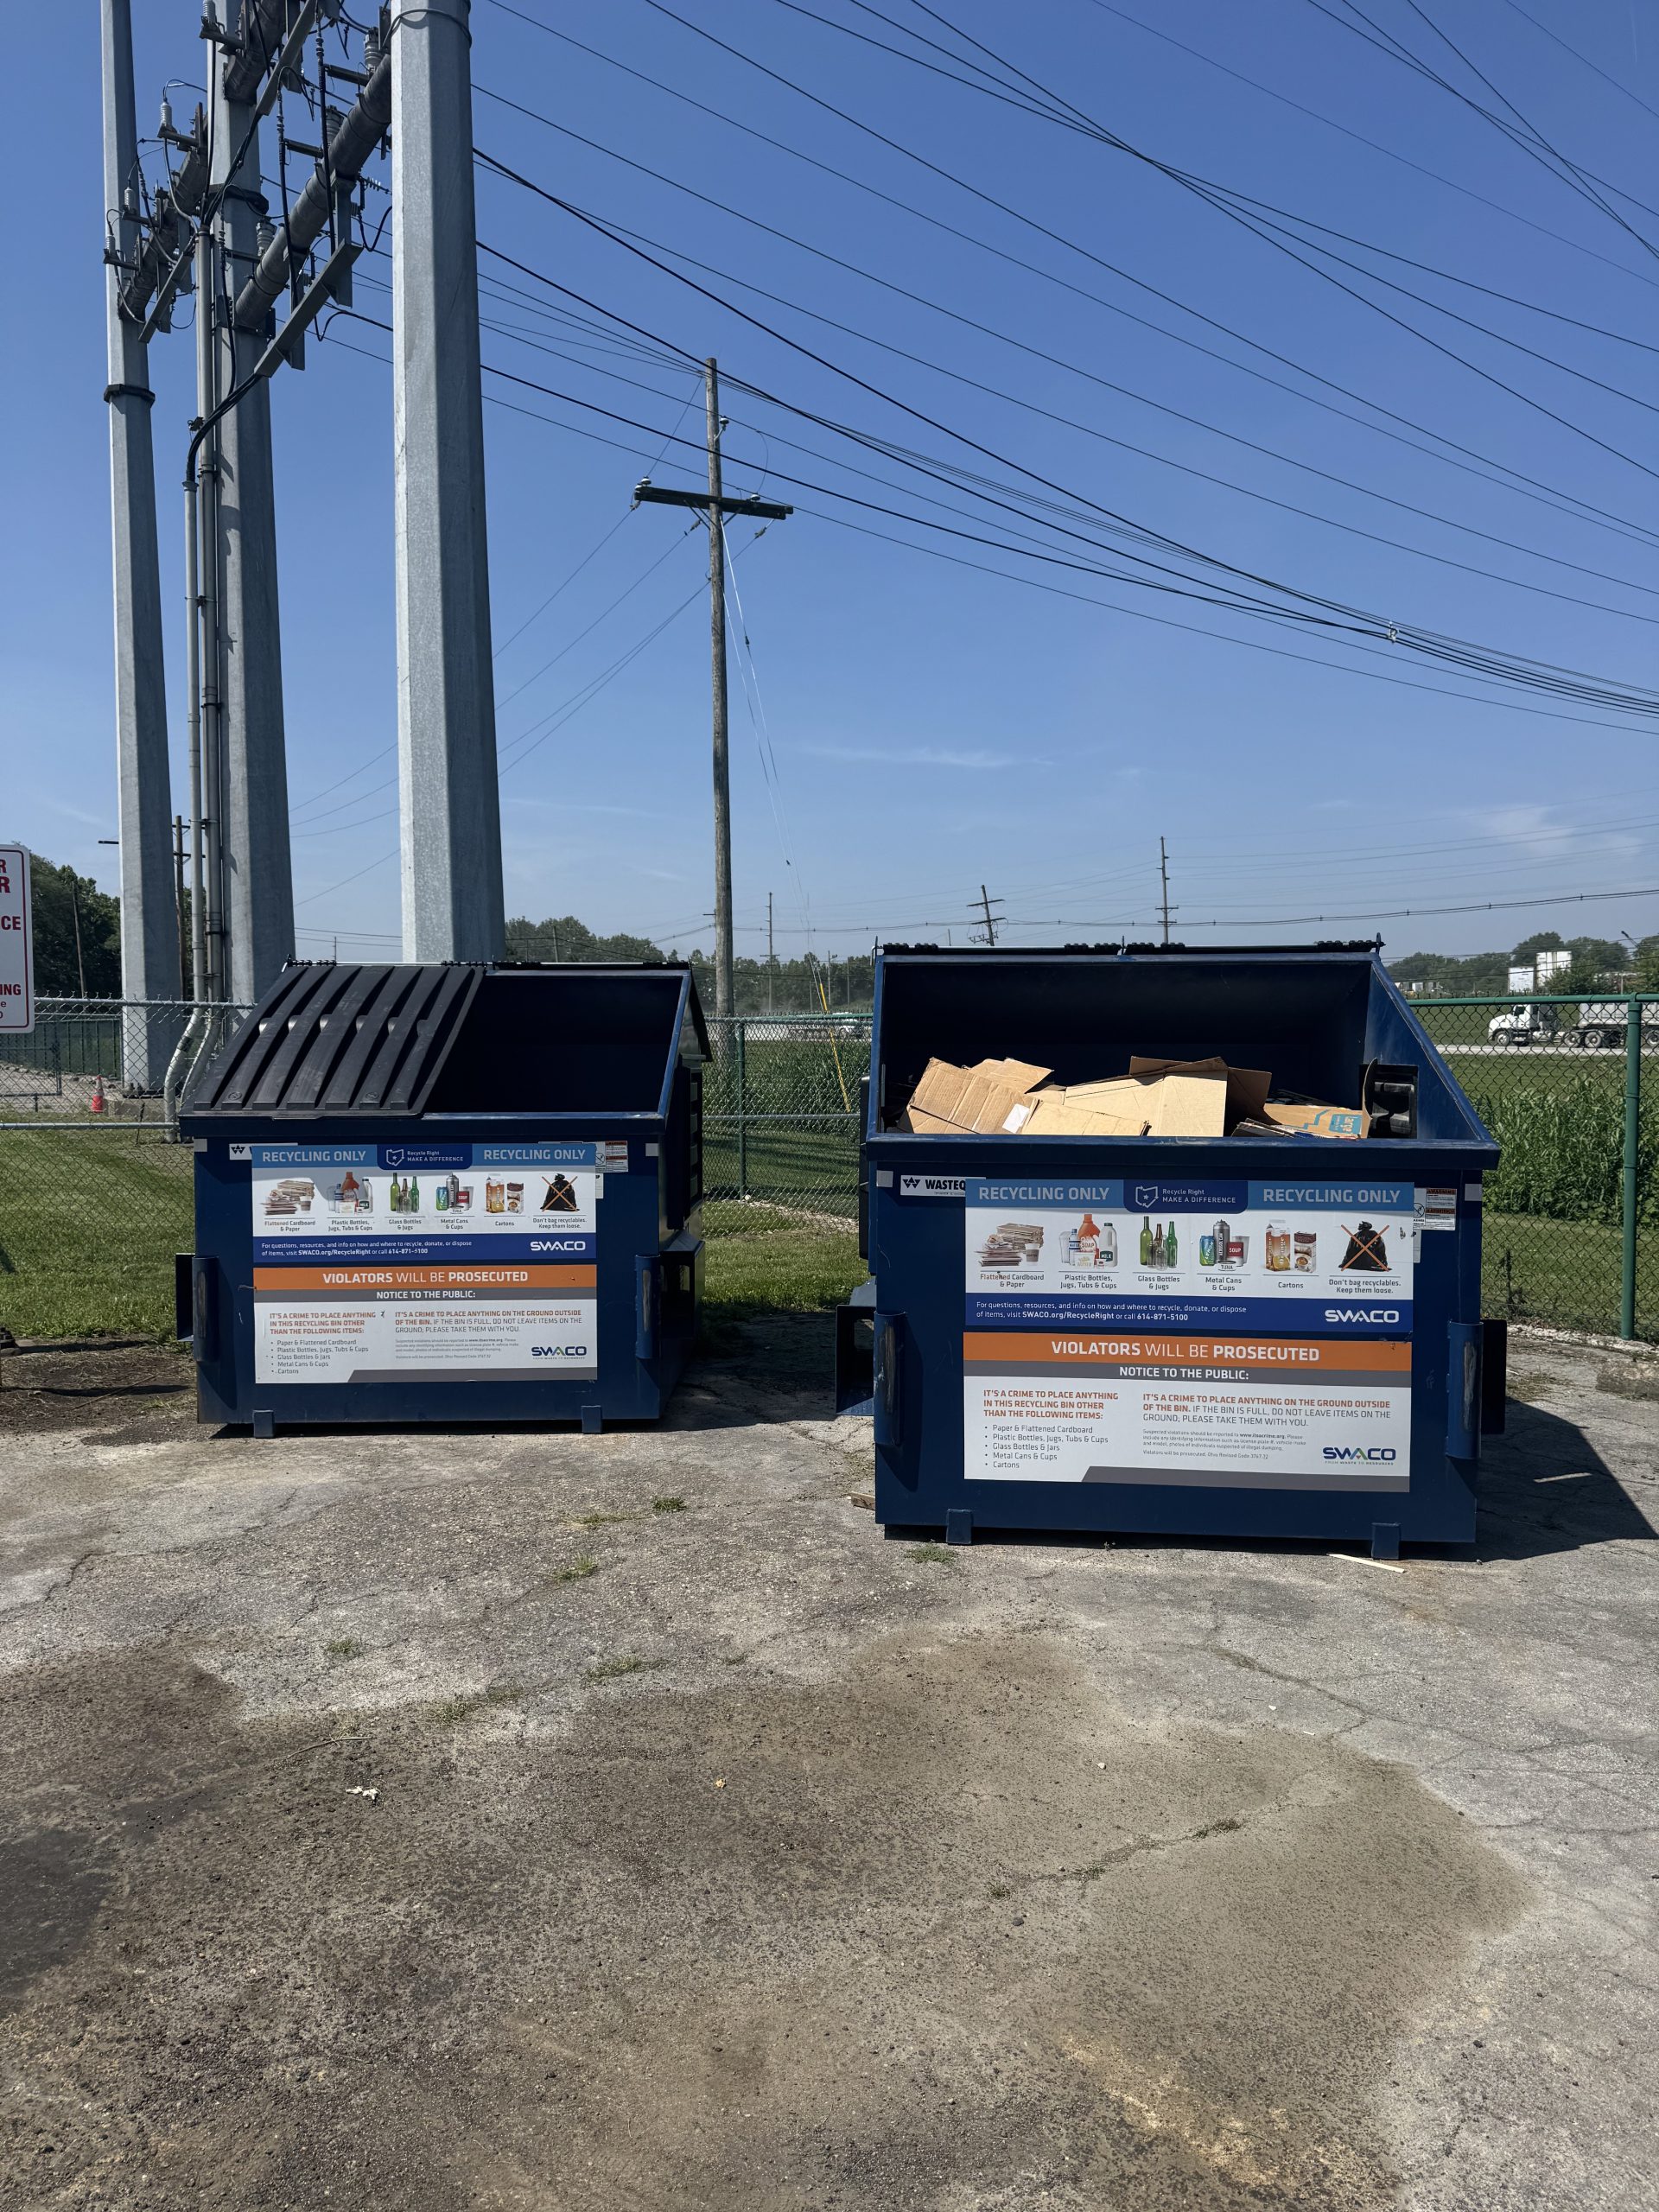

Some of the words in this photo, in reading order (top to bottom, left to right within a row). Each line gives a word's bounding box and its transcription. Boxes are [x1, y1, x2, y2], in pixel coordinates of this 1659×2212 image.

[262, 1150, 330, 1162] RECYCLING
[334, 1150, 365, 1161] ONLY
[483, 1148, 550, 1160] RECYCLING
[554, 1149, 585, 1160] ONLY
[979, 1186, 1064, 1199] RECYCLING
[1068, 1186, 1109, 1200] ONLY
[1263, 1188, 1352, 1203] RECYCLING
[1357, 1189, 1400, 1203] ONLY
[530, 1240, 586, 1251] SWACO
[322, 1272, 392, 1283] VIOLATORS
[396, 1272, 426, 1282] WILL
[429, 1271, 445, 1281] BE
[448, 1271, 528, 1281] PROSECUTED
[1348, 1279, 1361, 1287] bag
[410, 1290, 421, 1299] TO
[1022, 1310, 1114, 1320] SWACO.org/RecycleRight
[1324, 1309, 1399, 1323] SWACO
[531, 1346, 588, 1357] SWACO
[1051, 1340, 1141, 1356] VIOLATORS
[1144, 1343, 1184, 1357] WILL
[1189, 1344, 1208, 1357] BE
[1213, 1344, 1319, 1361] PROSECUTED
[1119, 1366, 1160, 1376] NOTICE
[1162, 1367, 1177, 1377] TO
[1179, 1368, 1202, 1378] THE
[1205, 1369, 1249, 1380] PUBLIC:
[1075, 1391, 1118, 1400] ANYTHING
[1168, 1394, 1195, 1402] CRIME
[1237, 1396, 1282, 1405] ANYTHING
[1298, 1398, 1315, 1407] THE
[1317, 1399, 1353, 1408] GROUND
[1354, 1400, 1390, 1408] OUTSIDE
[1025, 1409, 1073, 1419] FOLLOWING
[1075, 1411, 1103, 1420] ITEMS:
[1246, 1407, 1269, 1415] FULL,
[1271, 1407, 1283, 1415] DO
[1285, 1408, 1302, 1416] NOT
[1305, 1408, 1331, 1417] LEAVE
[1332, 1409, 1358, 1418] ITEMS
[1360, 1409, 1373, 1418] ON
[1374, 1410, 1391, 1419] THE
[1182, 1414, 1213, 1423] PLEASE
[1215, 1415, 1236, 1424] TAKE
[1238, 1416, 1262, 1425] THEM
[1264, 1417, 1287, 1426] WITH
[1288, 1418, 1308, 1427] YOU.
[1020, 1424, 1055, 1433] Flattened
[1057, 1425, 1093, 1433] Cardboard
[1090, 1435, 1108, 1444] Cups
[992, 1441, 1011, 1450] Glass
[1013, 1442, 1039, 1451] Bottles
[1039, 1442, 1046, 1451] &
[1039, 1452, 1057, 1461] Cups
[1322, 1446, 1396, 1461] SWACO
